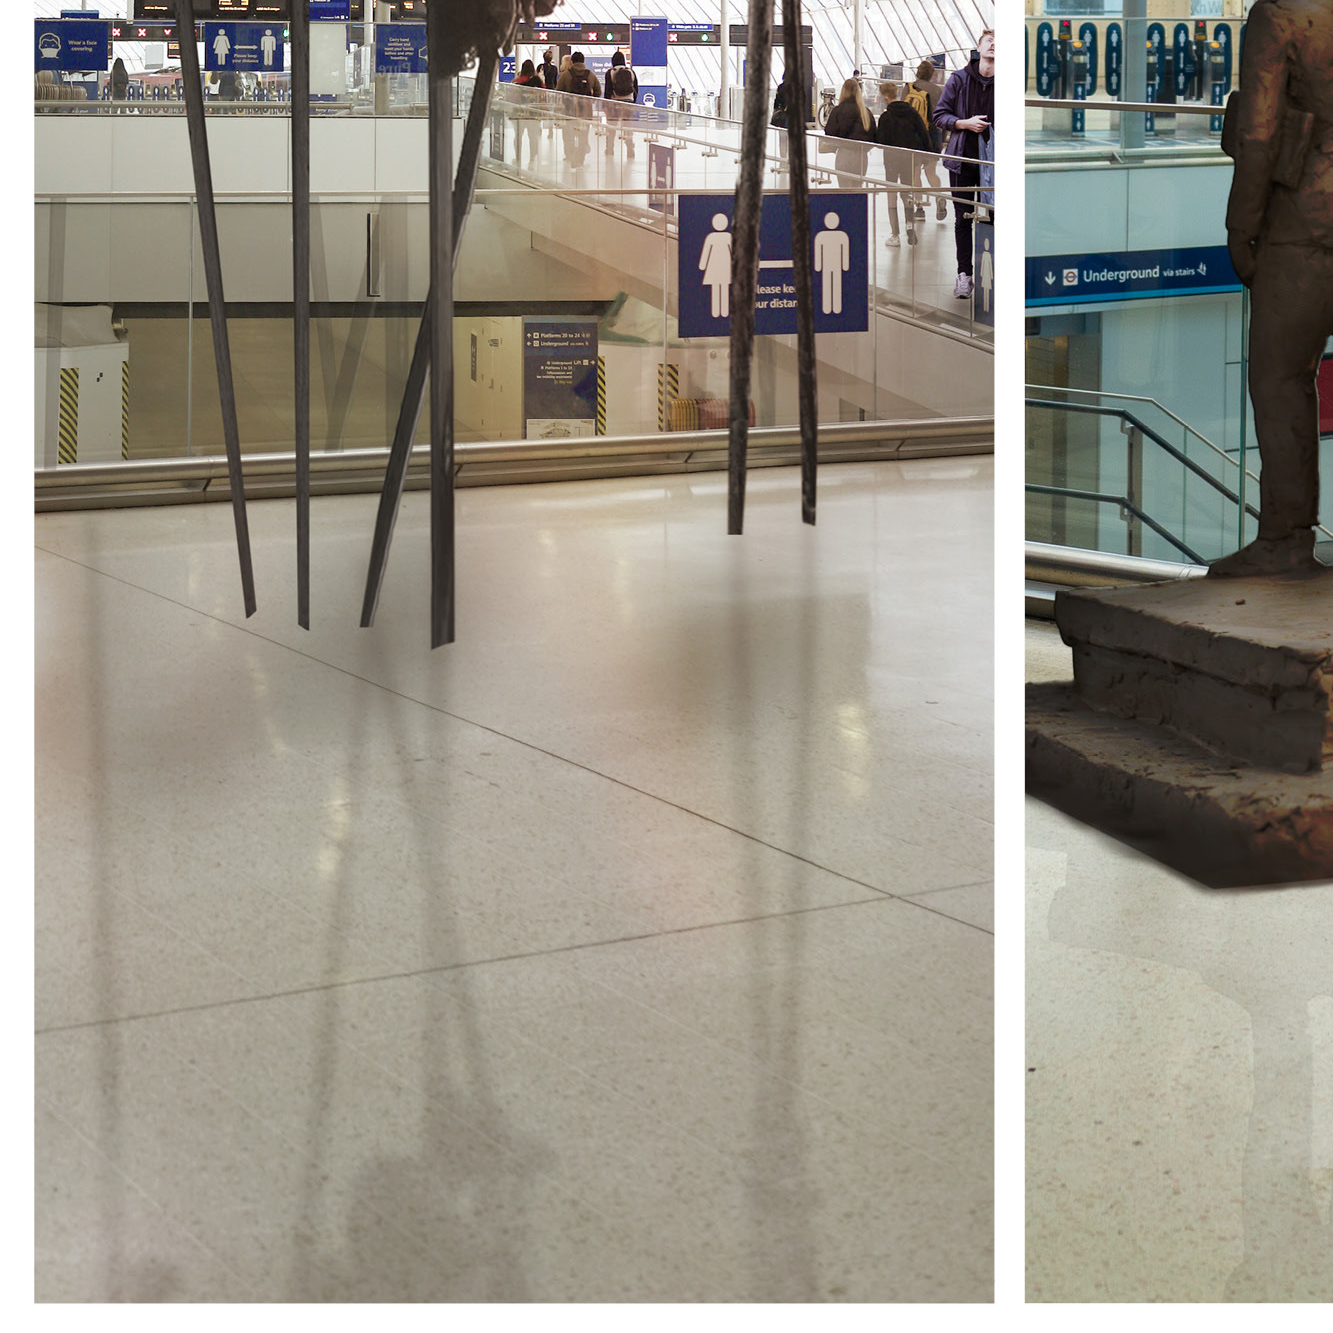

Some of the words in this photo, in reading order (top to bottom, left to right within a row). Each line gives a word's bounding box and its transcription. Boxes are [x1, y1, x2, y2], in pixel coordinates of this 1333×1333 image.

[502, 61, 516, 74] 23
[1083, 266, 1160, 283] Underground
[1163, 269, 1173, 277] via
[1175, 267, 1195, 277] stairs
[756, 284, 781, 294] lease
[782, 283, 797, 294] ke
